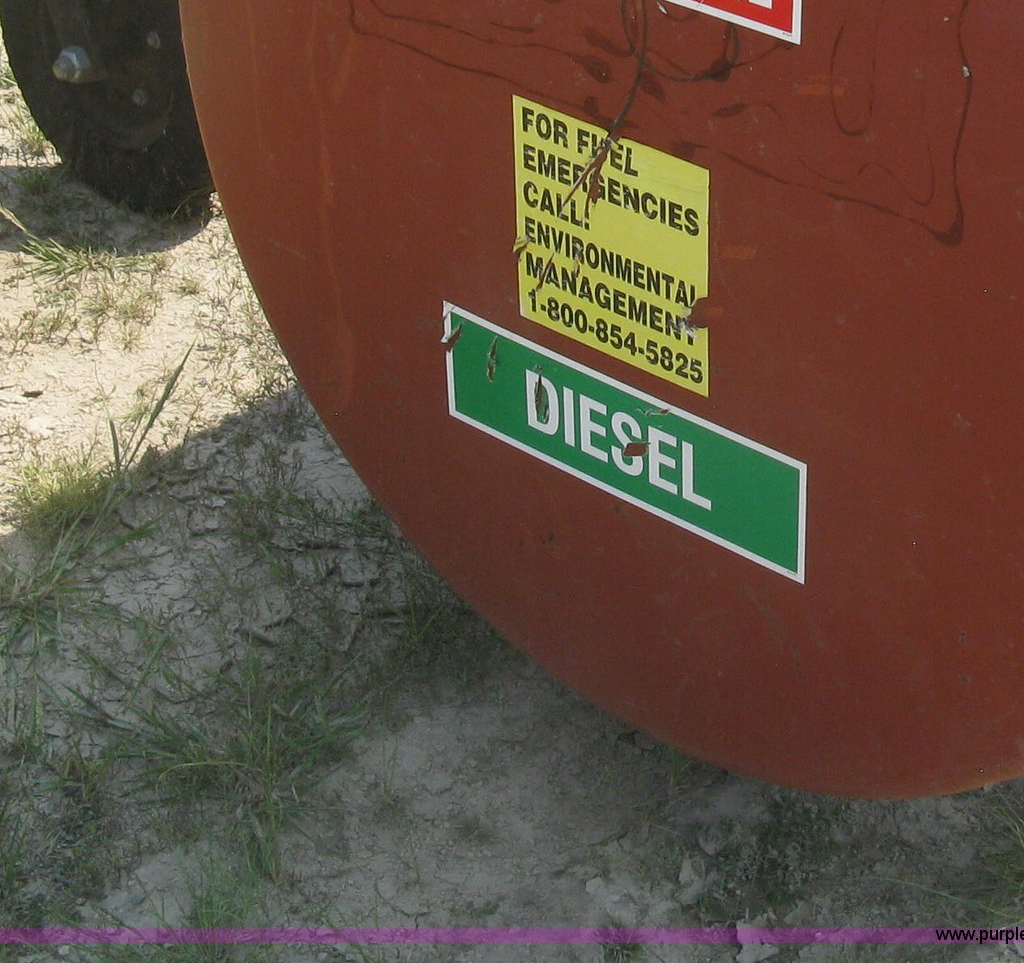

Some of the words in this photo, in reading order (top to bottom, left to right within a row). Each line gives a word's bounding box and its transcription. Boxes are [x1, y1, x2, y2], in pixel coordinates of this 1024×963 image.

[521, 106, 569, 149] FOR
[528, 288, 704, 384] 1-800-854-5825
[525, 368, 712, 511] DIESEL
